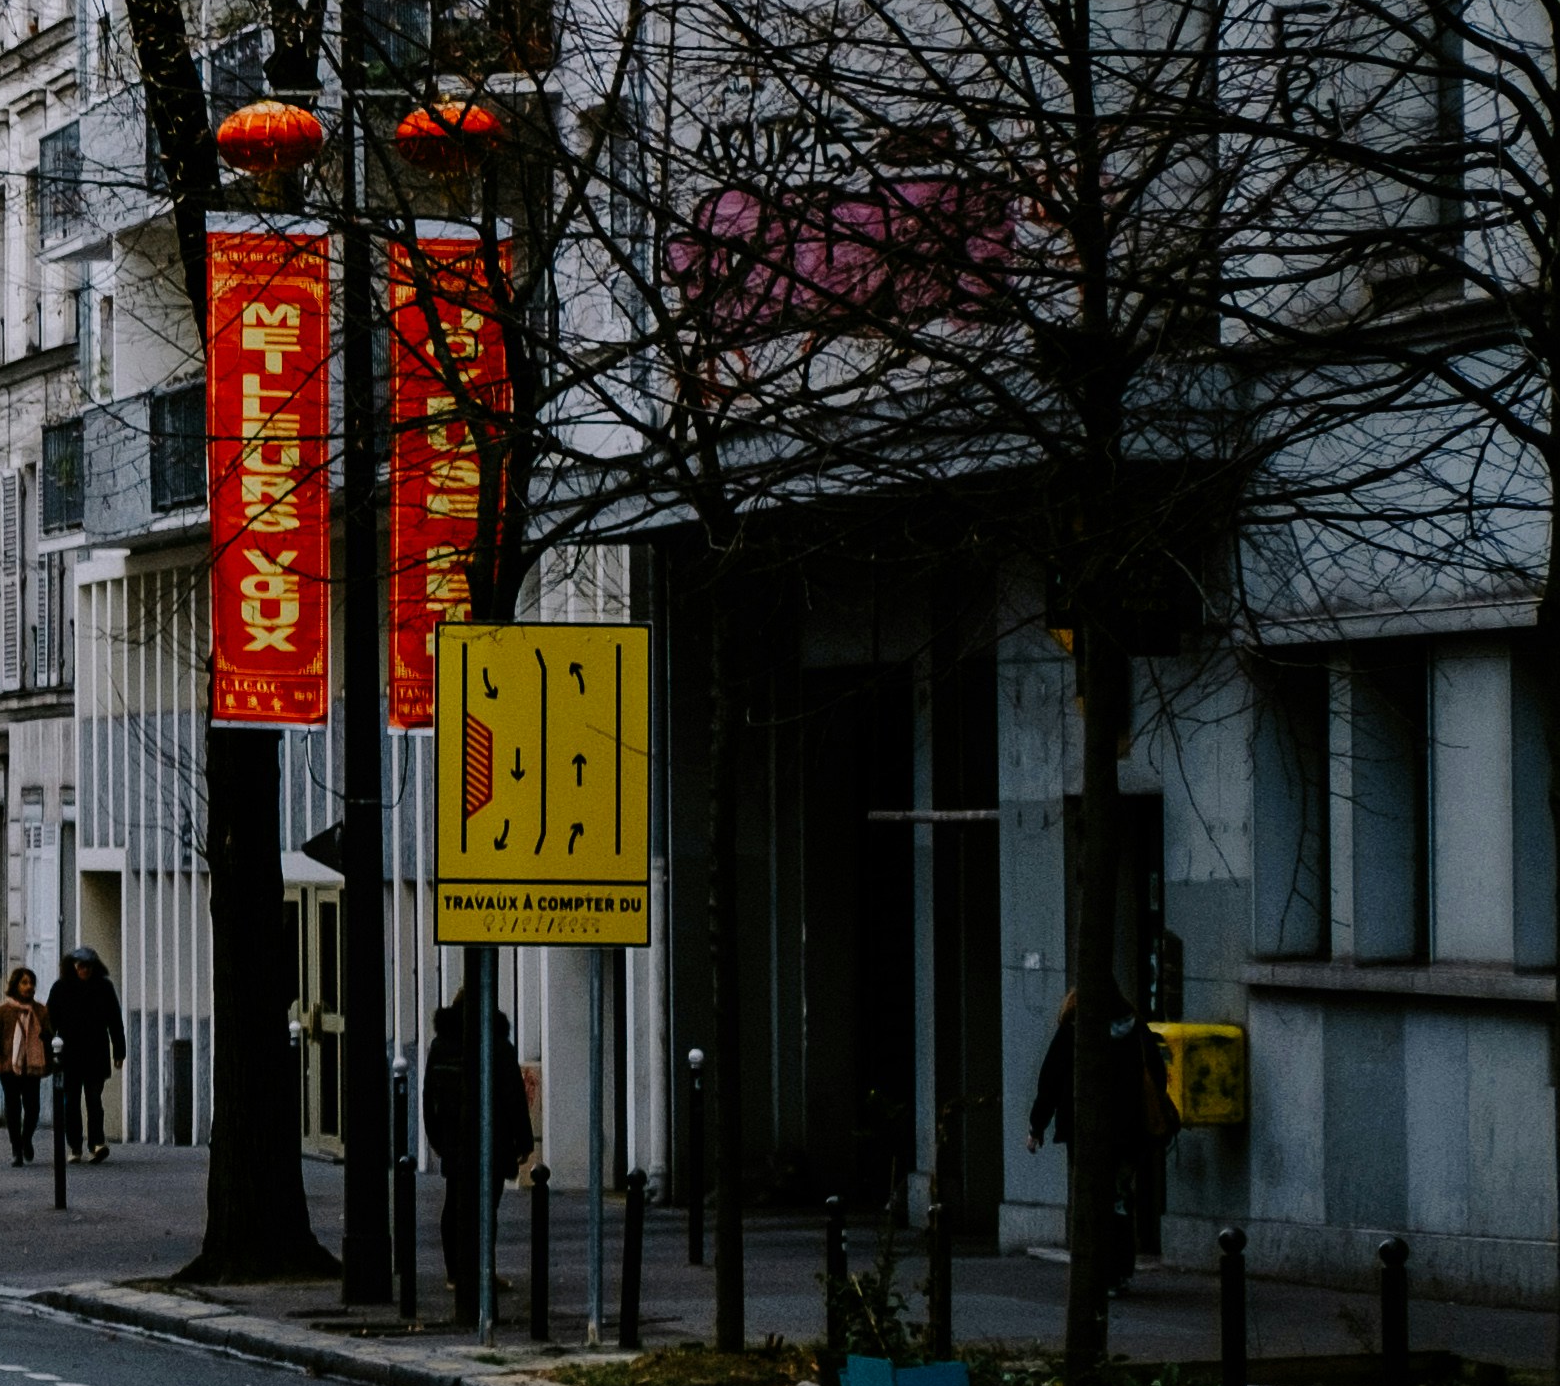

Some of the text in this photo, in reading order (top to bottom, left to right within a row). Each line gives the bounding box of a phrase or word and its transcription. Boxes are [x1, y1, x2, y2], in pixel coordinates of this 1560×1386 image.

[241, 302, 301, 533] MEILLEURS
[444, 894, 518, 912] TRAVAUX
[537, 895, 615, 913] COMPTER
[619, 897, 642, 913] DU
